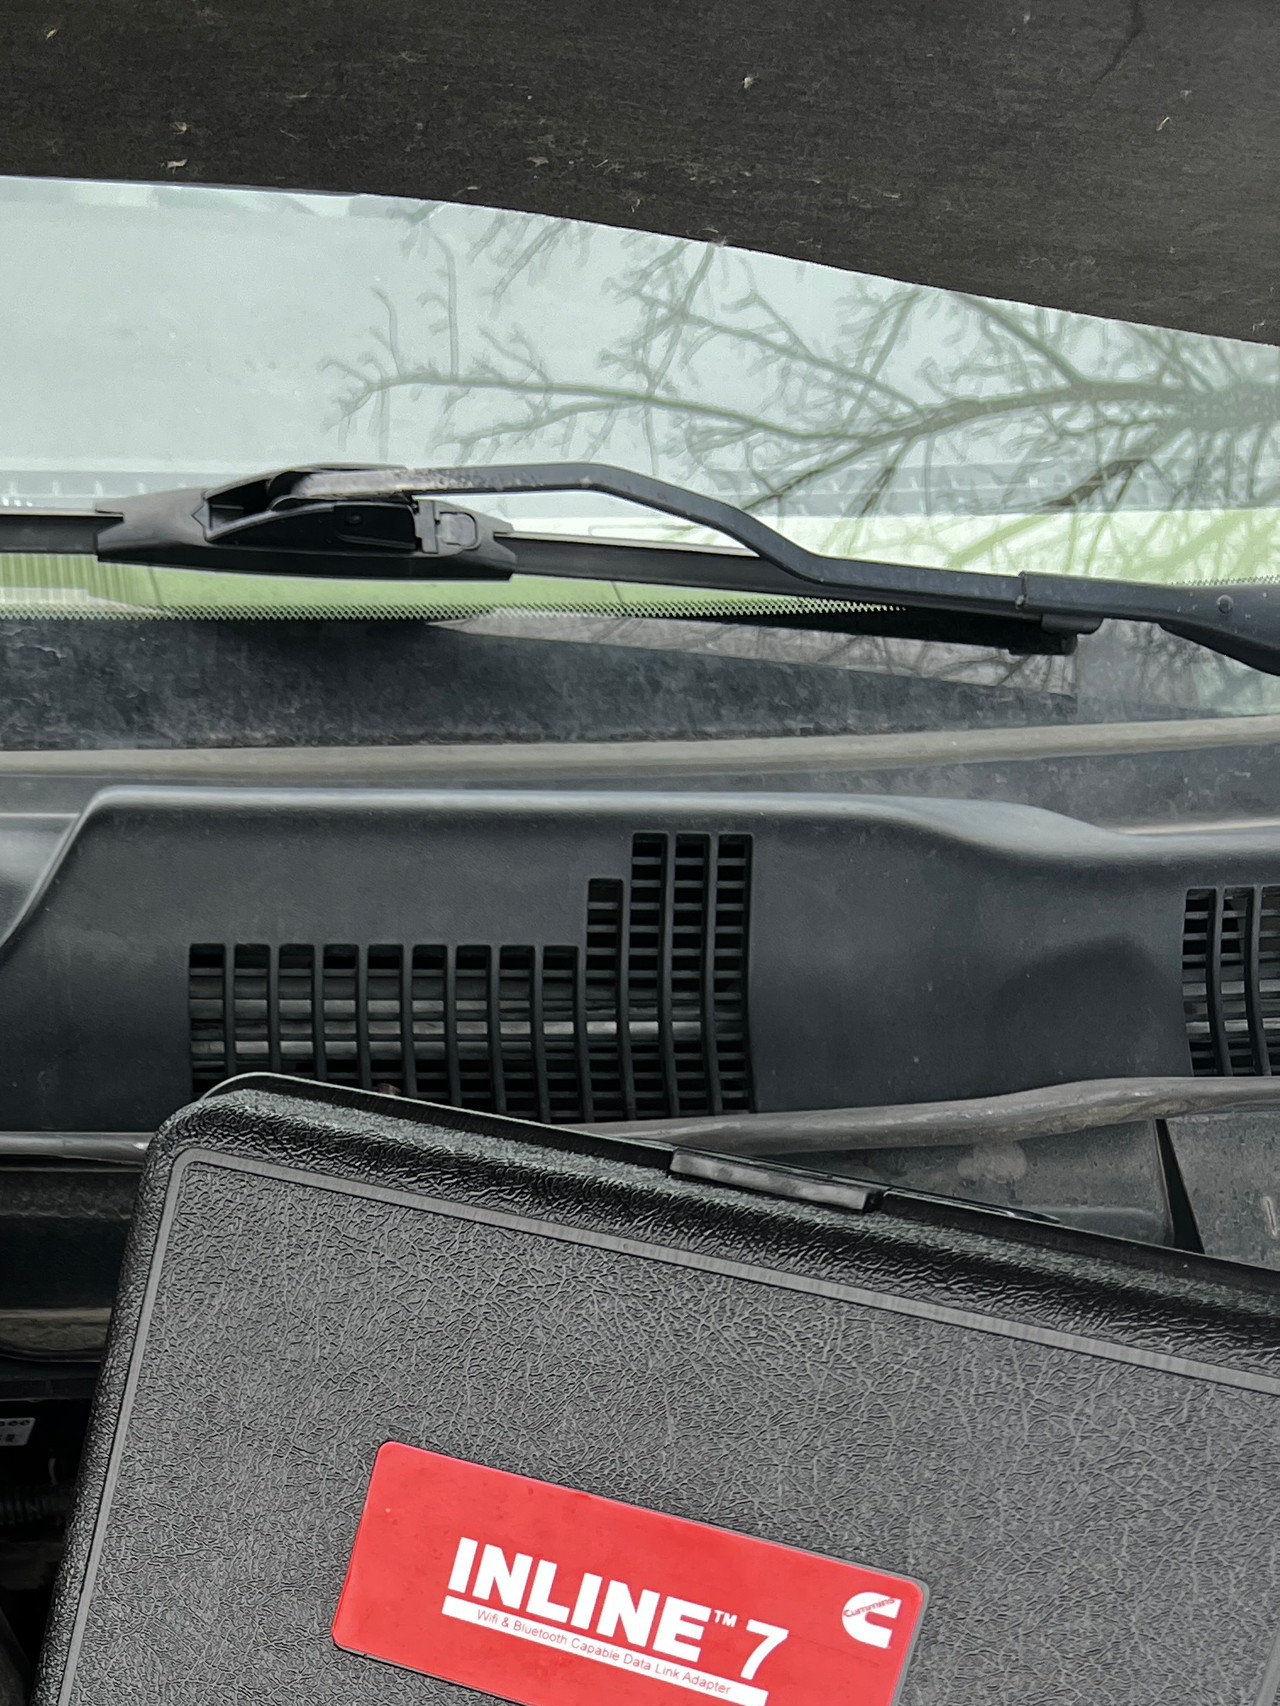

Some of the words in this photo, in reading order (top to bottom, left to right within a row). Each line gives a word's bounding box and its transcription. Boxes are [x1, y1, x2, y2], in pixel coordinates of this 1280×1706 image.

[447, 1536, 712, 1662] INLINE
[740, 1618, 789, 1681] 7
[477, 1608, 499, 1625] Wifi
[500, 1616, 510, 1628] &
[513, 1619, 568, 1645] Bluetooth
[570, 1637, 621, 1662] Capable
[622, 1653, 652, 1672] Data
[654, 1662, 680, 1680] Link
[681, 1671, 732, 1695] Adapter
[843, 1598, 895, 1618] Cummins
